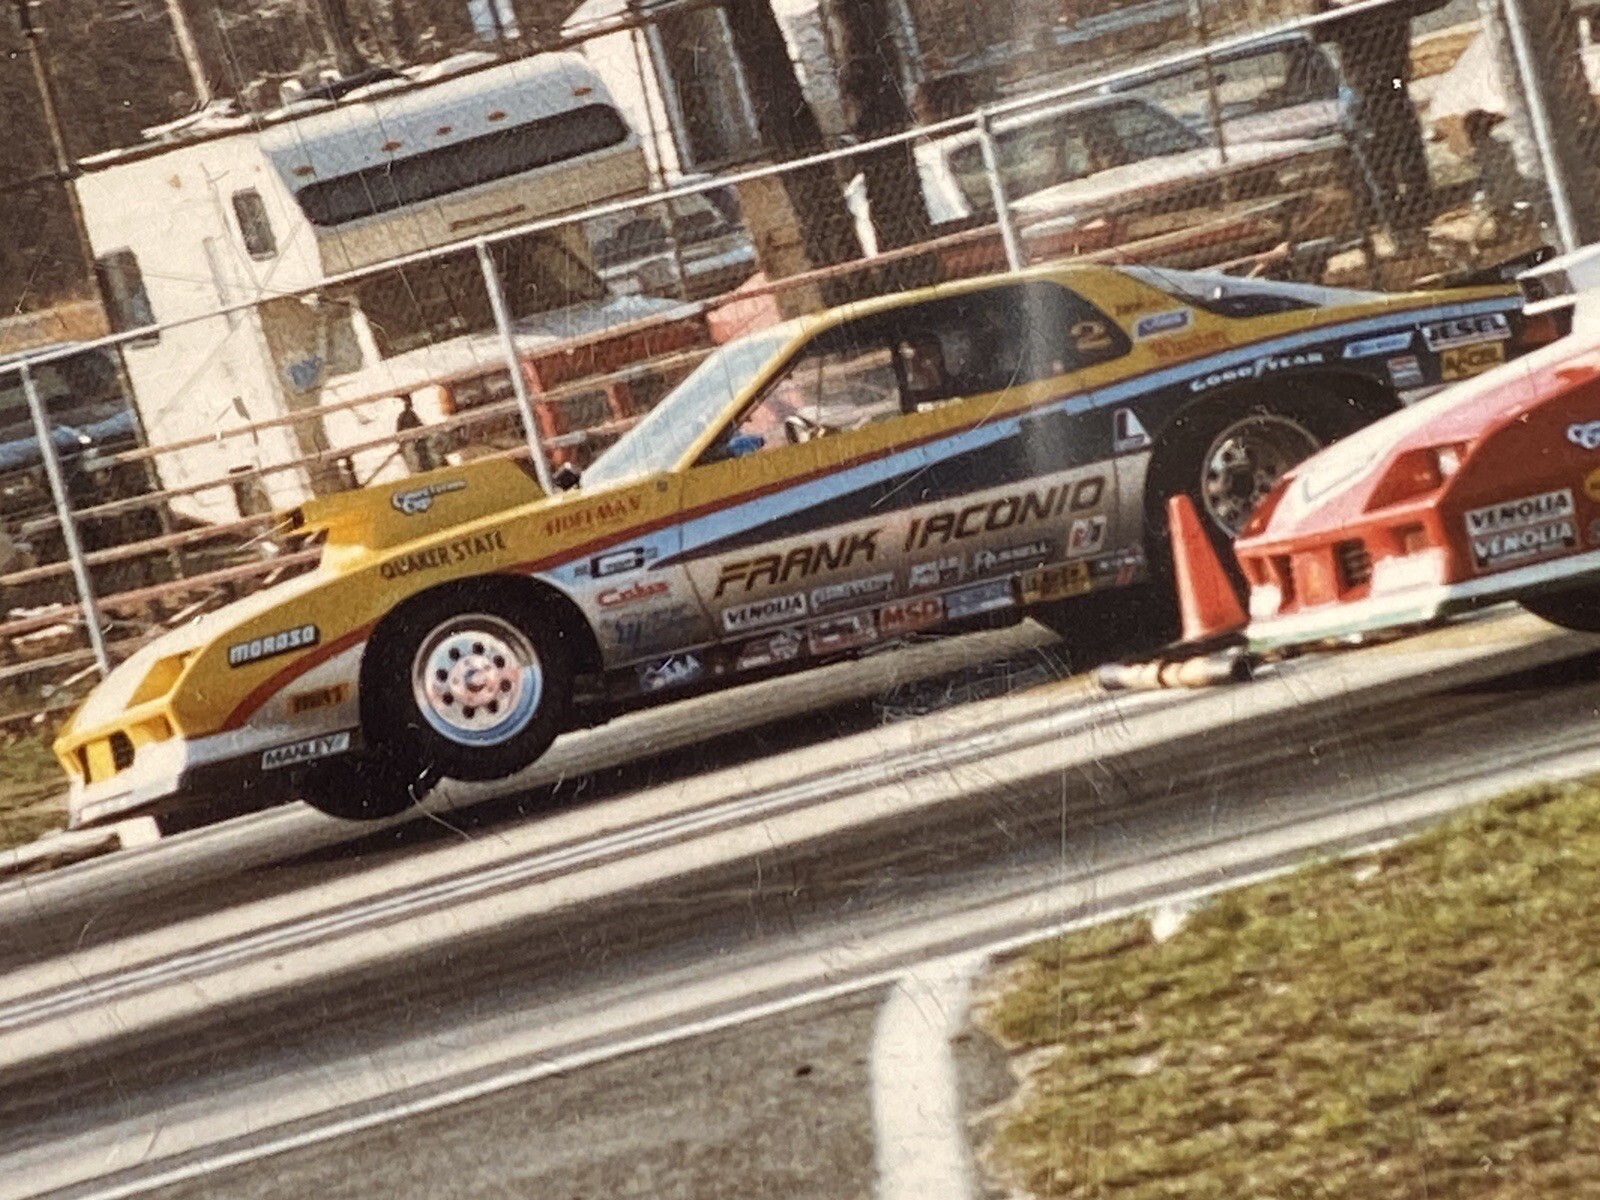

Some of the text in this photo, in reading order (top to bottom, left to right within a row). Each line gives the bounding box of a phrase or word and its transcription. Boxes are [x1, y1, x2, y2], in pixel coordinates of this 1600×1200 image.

[1070, 321, 1112, 349] 2
[1190, 352, 1323, 392] GOODYEAR
[1470, 493, 1569, 529] VENOLIA
[379, 530, 506, 581] QUAKER STATE
[713, 526, 884, 600] FRANK
[902, 475, 1106, 553] IACONIO
[1473, 522, 1575, 558] VENOLIA
[726, 595, 803, 625] VENOLIA
[882, 599, 942, 630] MSD
[265, 738, 335, 767] MANLEY
